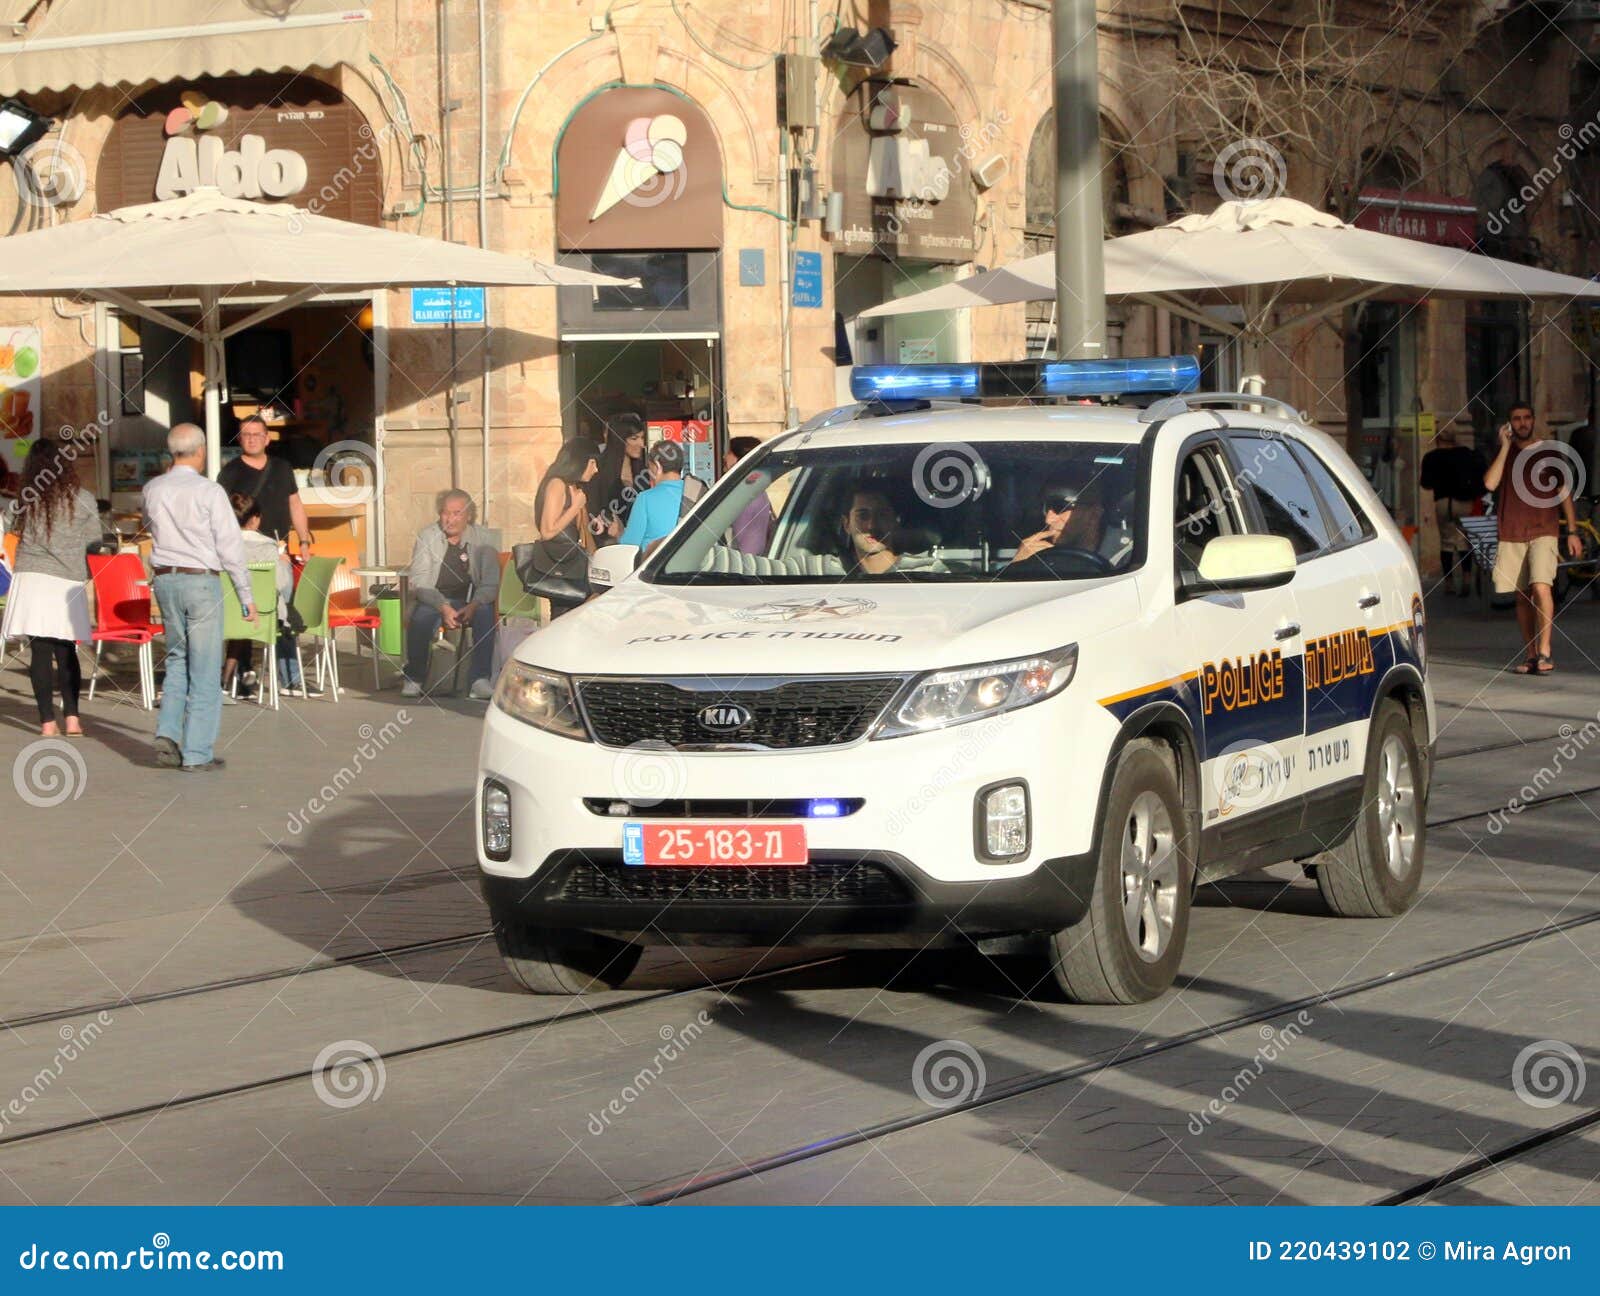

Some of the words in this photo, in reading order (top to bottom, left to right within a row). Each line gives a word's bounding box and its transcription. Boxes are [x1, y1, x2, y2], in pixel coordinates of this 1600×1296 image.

[155, 134, 308, 200] Aldo
[627, 631, 760, 645] POLICE
[767, 631, 902, 643] משטרה
[1304, 626, 1375, 690] משטרה
[1202, 648, 1284, 715] POLICE
[705, 709, 741, 725] KIA
[1308, 739, 1350, 772] משטרת
